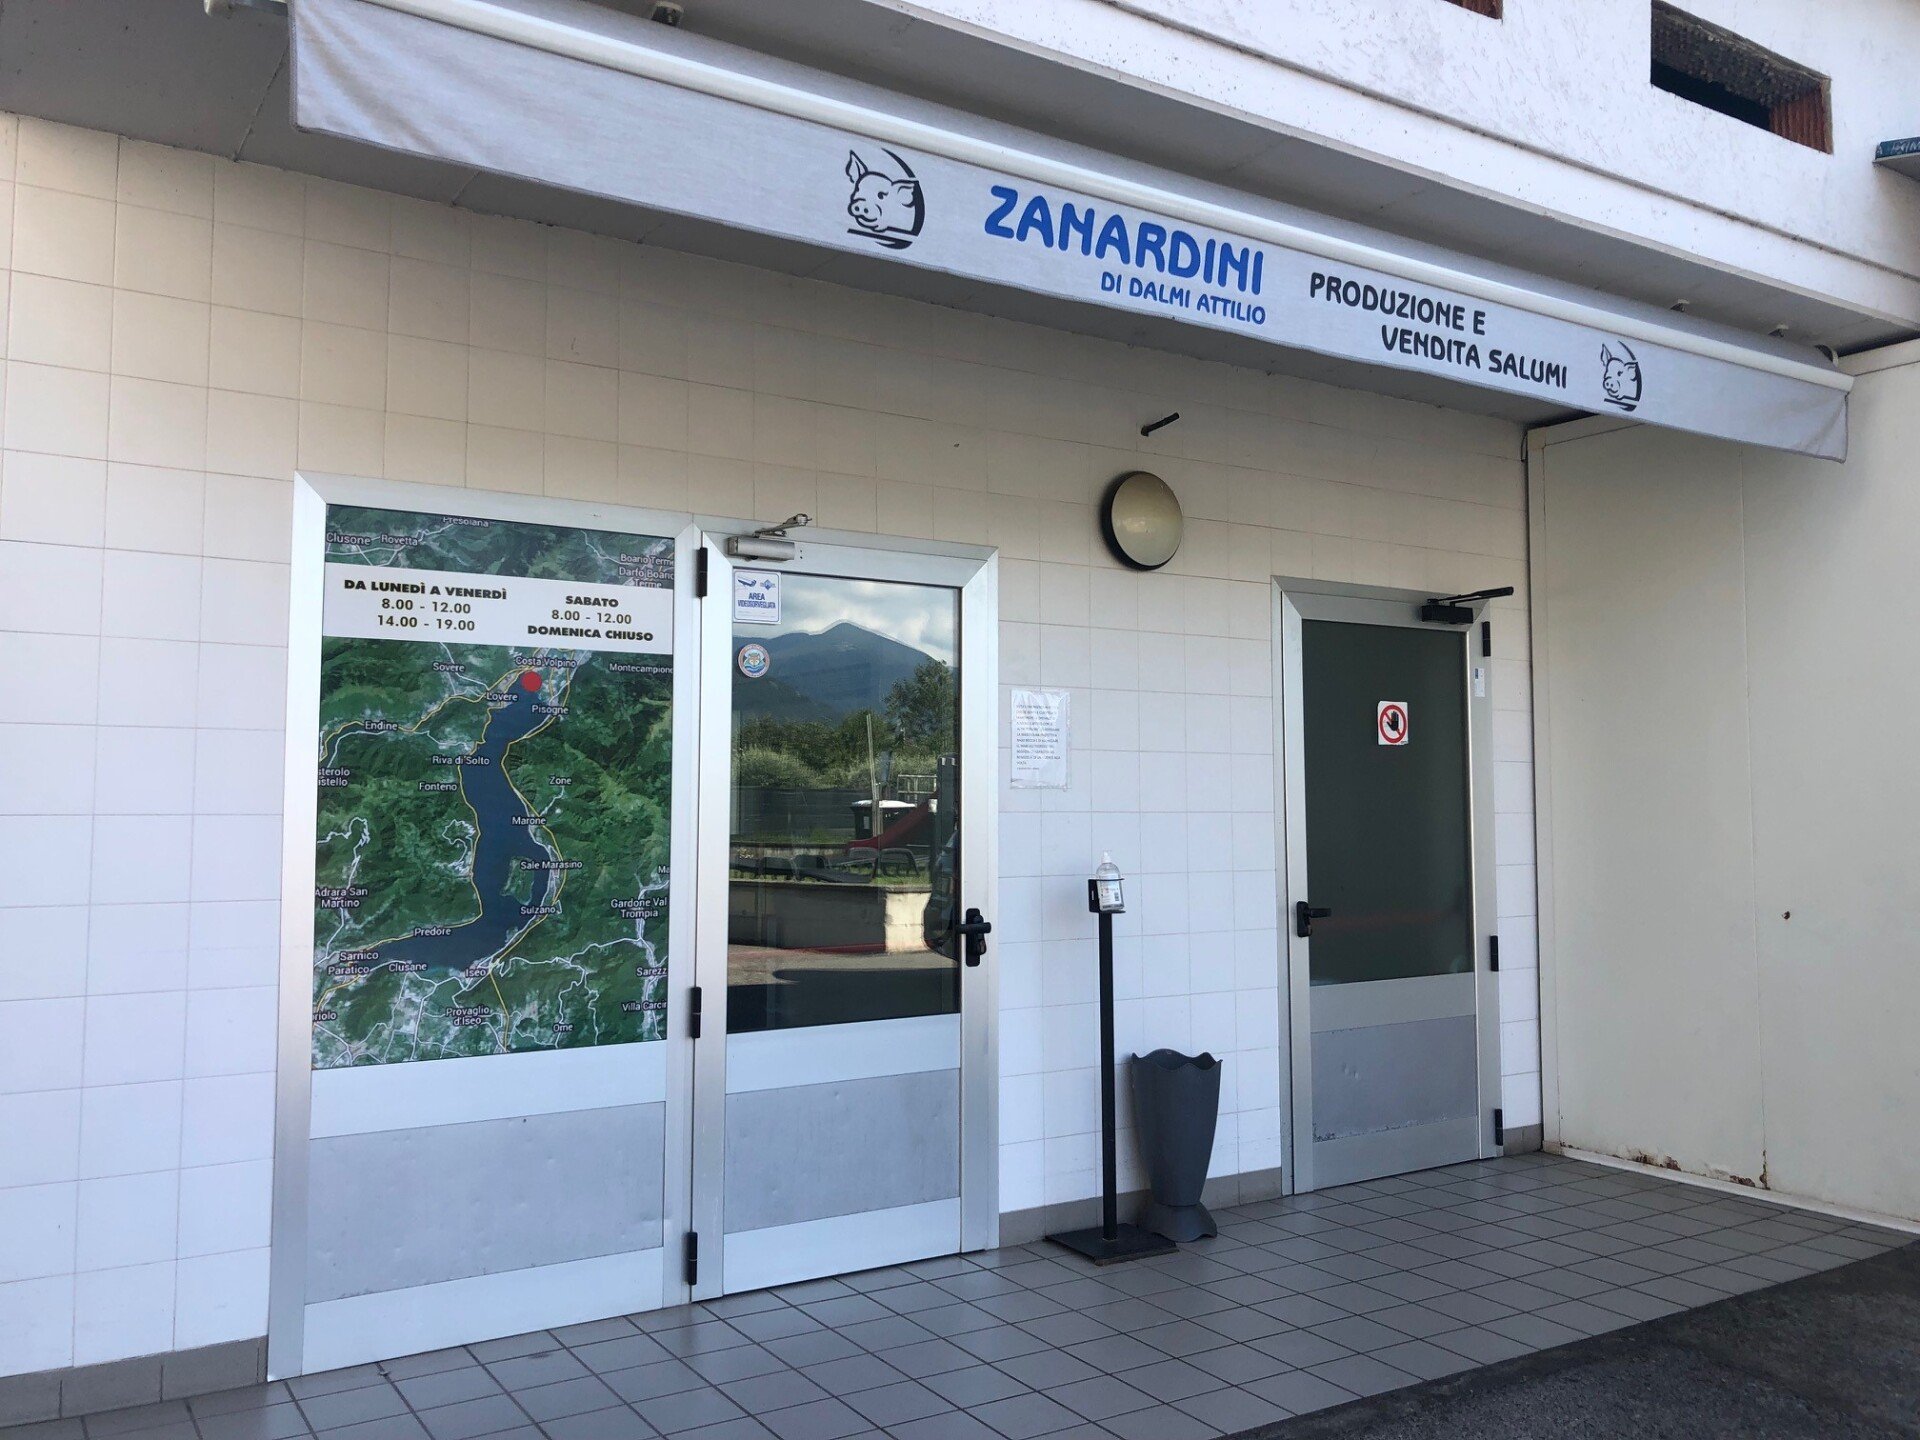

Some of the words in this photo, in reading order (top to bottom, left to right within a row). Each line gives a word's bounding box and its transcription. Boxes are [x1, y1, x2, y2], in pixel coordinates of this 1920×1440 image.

[985, 186, 1264, 296] ZANARDINI
[1100, 271, 1122, 294] DI
[1128, 277, 1191, 308] DALMI
[1196, 293, 1266, 325] ATTILIO
[1310, 272, 1466, 332] PRODUZIONE
[1472, 310, 1486, 336] E
[1381, 324, 1481, 370] VENDITA
[1488, 349, 1568, 389] SALUMI
[326, 533, 371, 546] Clusone
[381, 535, 418, 546] Rovetta
[619, 567, 644, 577] Darfo
[633, 579, 662, 588] Terme
[344, 579, 367, 591] DA
[371, 579, 426, 595] LUNEDÌ
[430, 585, 441, 596] A
[445, 586, 507, 600] VENERDÌ
[565, 595, 619, 608] SABATO
[748, 592, 766, 601] AREA
[381, 598, 414, 611] 8.00
[432, 601, 471, 614] 12.00
[377, 614, 418, 628] 14.00
[436, 618, 475, 631] 19.00
[551, 609, 580, 621] 8.00
[597, 612, 632, 625] 12.00
[527, 625, 602, 639] DOMENICA
[605, 630, 654, 642] CHIUSO
[433, 662, 465, 672] Sovere
[515, 656, 541, 667] Costa
[544, 657, 577, 669] Volpino
[486, 692, 518, 702] Lovere
[531, 705, 569, 716] Pisogne
[364, 719, 398, 731] Endine
[432, 755, 453, 765] Riva
[455, 755, 464, 765] di
[465, 756, 490, 766] Solto
[550, 774, 572, 786] Zone
[419, 780, 457, 792] Fonteno
[512, 815, 546, 826] Marone
[520, 859, 544, 870] Sale
[547, 859, 583, 870] Marasino
[315, 887, 346, 897] Adrara
[349, 886, 368, 896] San
[321, 899, 360, 908] Martino
[610, 897, 651, 909] Gardone
[652, 896, 668, 907] Val
[520, 904, 556, 915] Sulzano
[621, 908, 659, 919] Trompia
[414, 926, 451, 938] Predore
[340, 951, 379, 962] Sarnico
[328, 965, 370, 975] Paratico
[388, 962, 428, 973] Clusane
[465, 967, 487, 977] Iseo
[446, 1006, 490, 1018] Provaglio
[622, 1002, 641, 1012] Villa
[453, 1016, 482, 1026] d'Iseo
[553, 1023, 573, 1032] Ome
